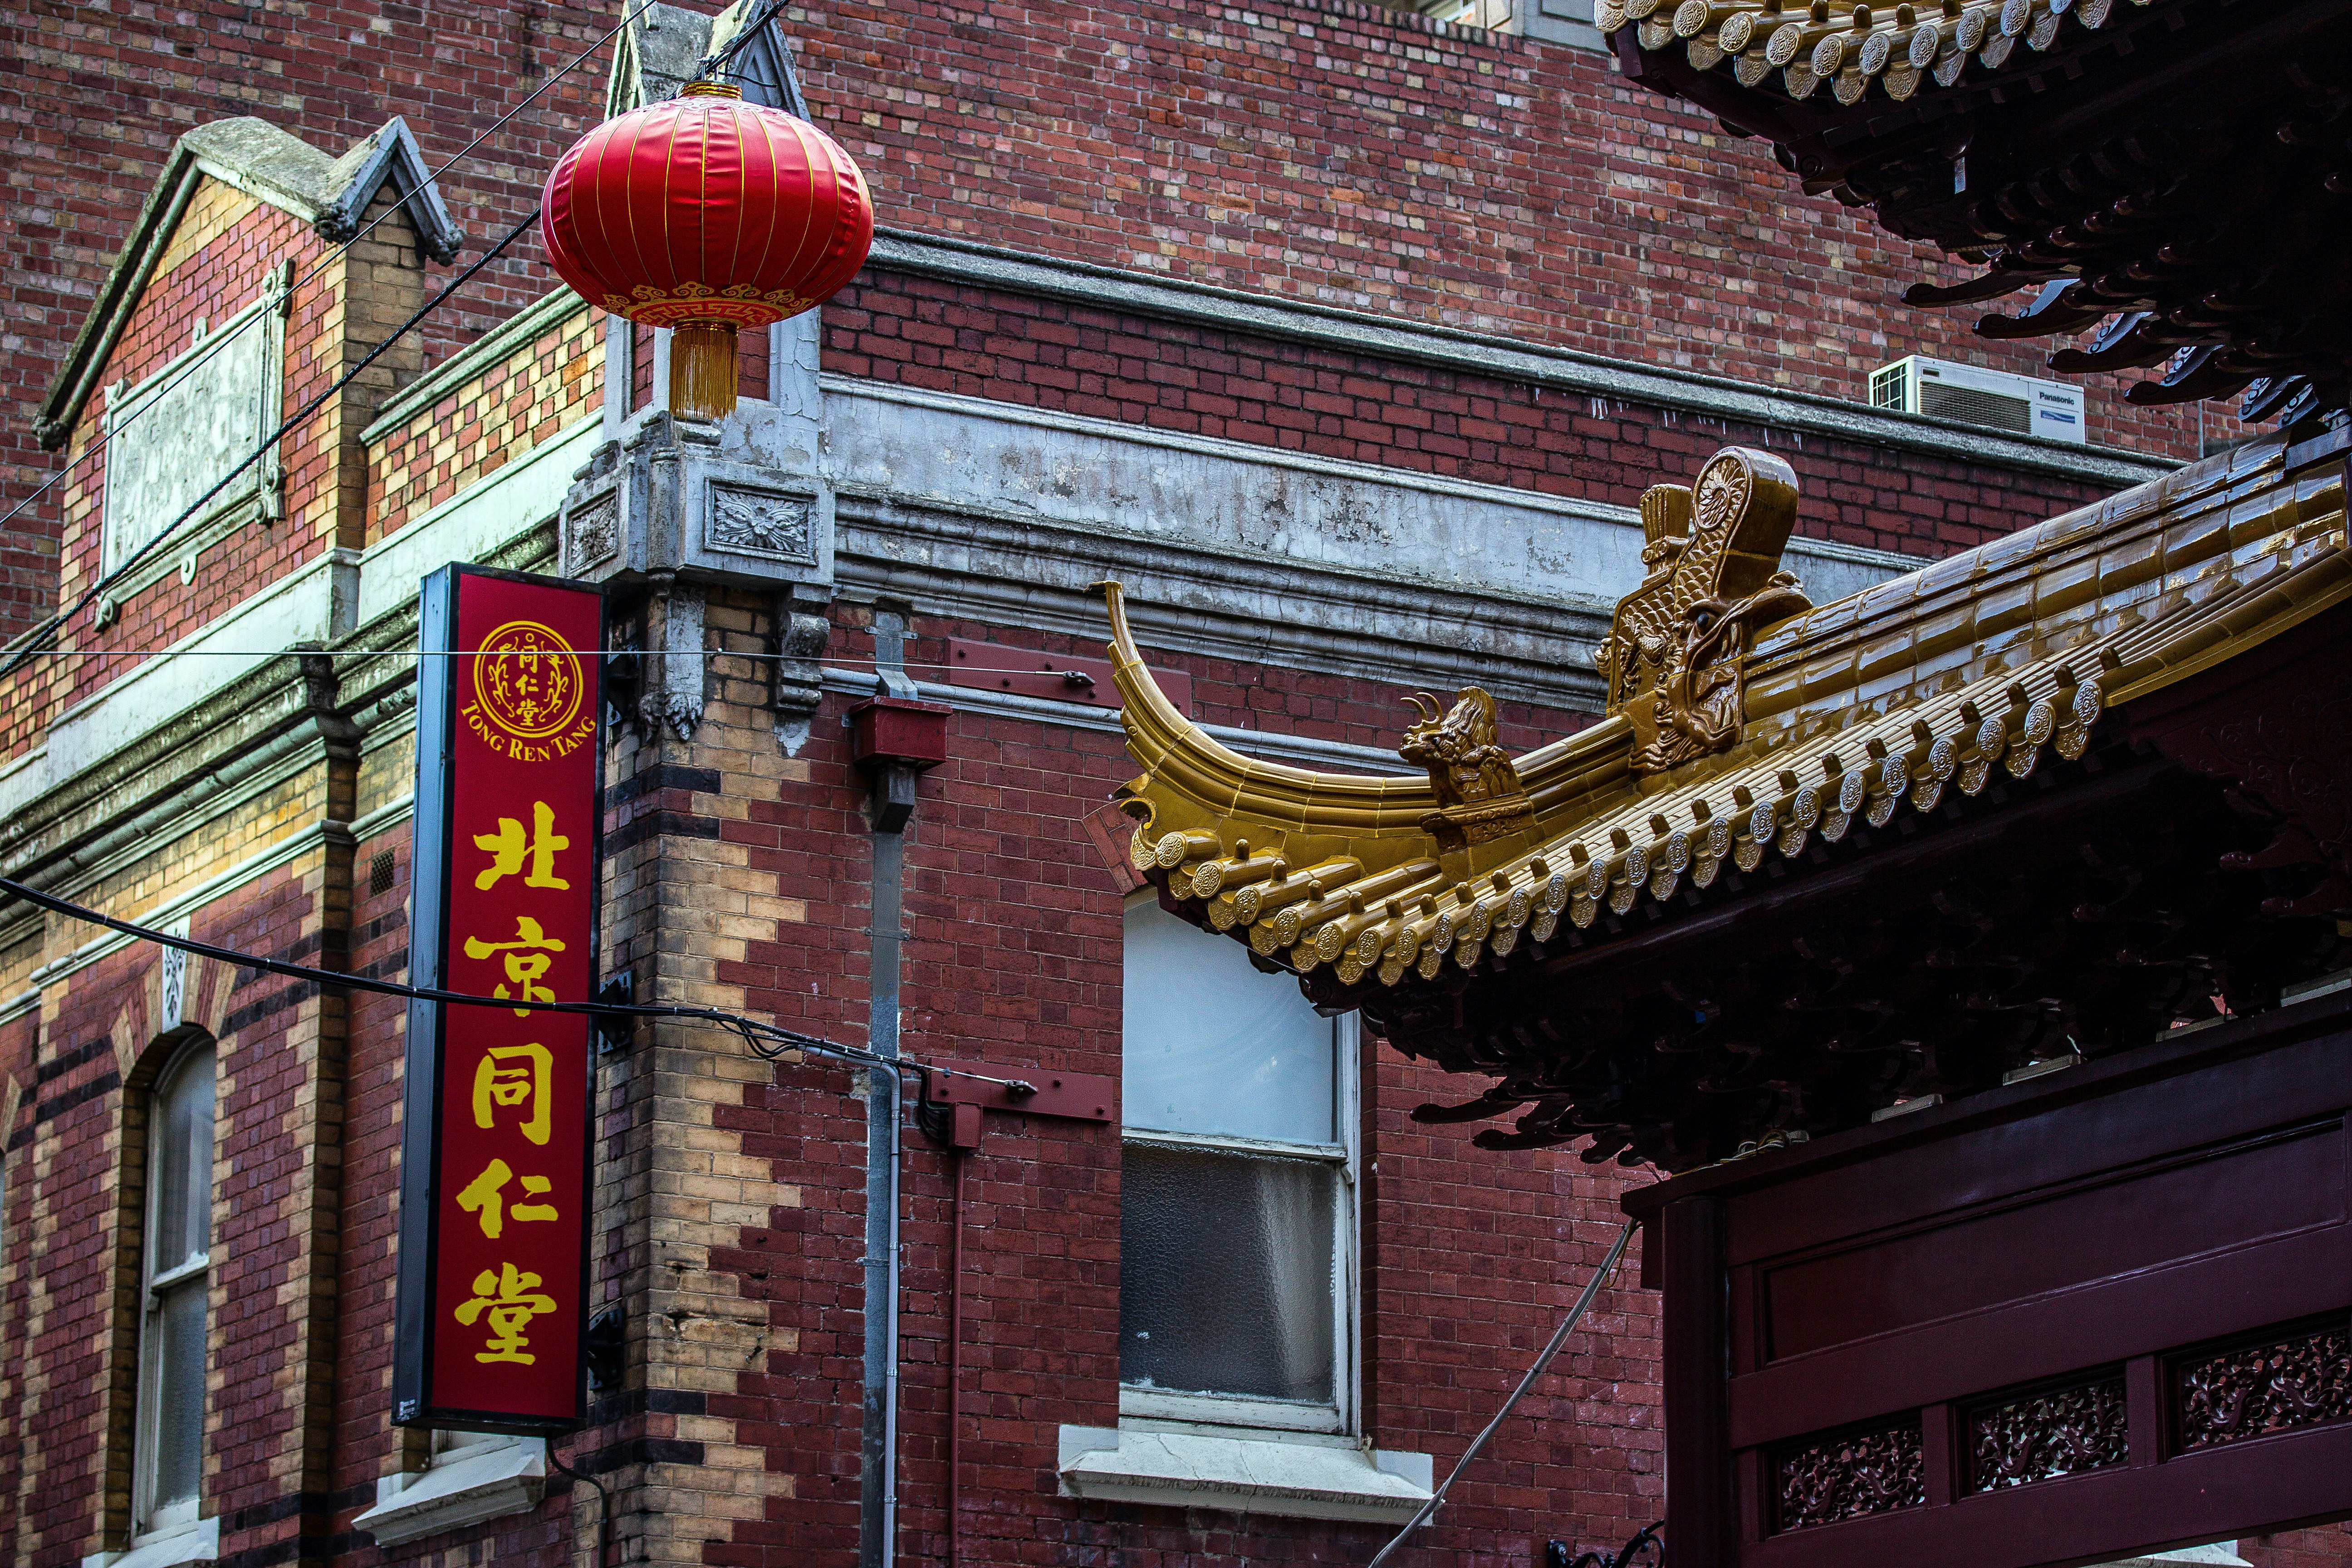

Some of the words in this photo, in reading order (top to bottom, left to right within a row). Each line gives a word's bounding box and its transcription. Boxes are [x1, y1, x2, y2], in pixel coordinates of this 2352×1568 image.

[2039, 392, 2074, 405] Panasonic
[514, 645, 539, 727] 同仁堂
[461, 700, 505, 751] TONG
[508, 738, 551, 762] REN
[550, 716, 596, 758] TANG
[454, 800, 570, 1366] 北京同仁堂
